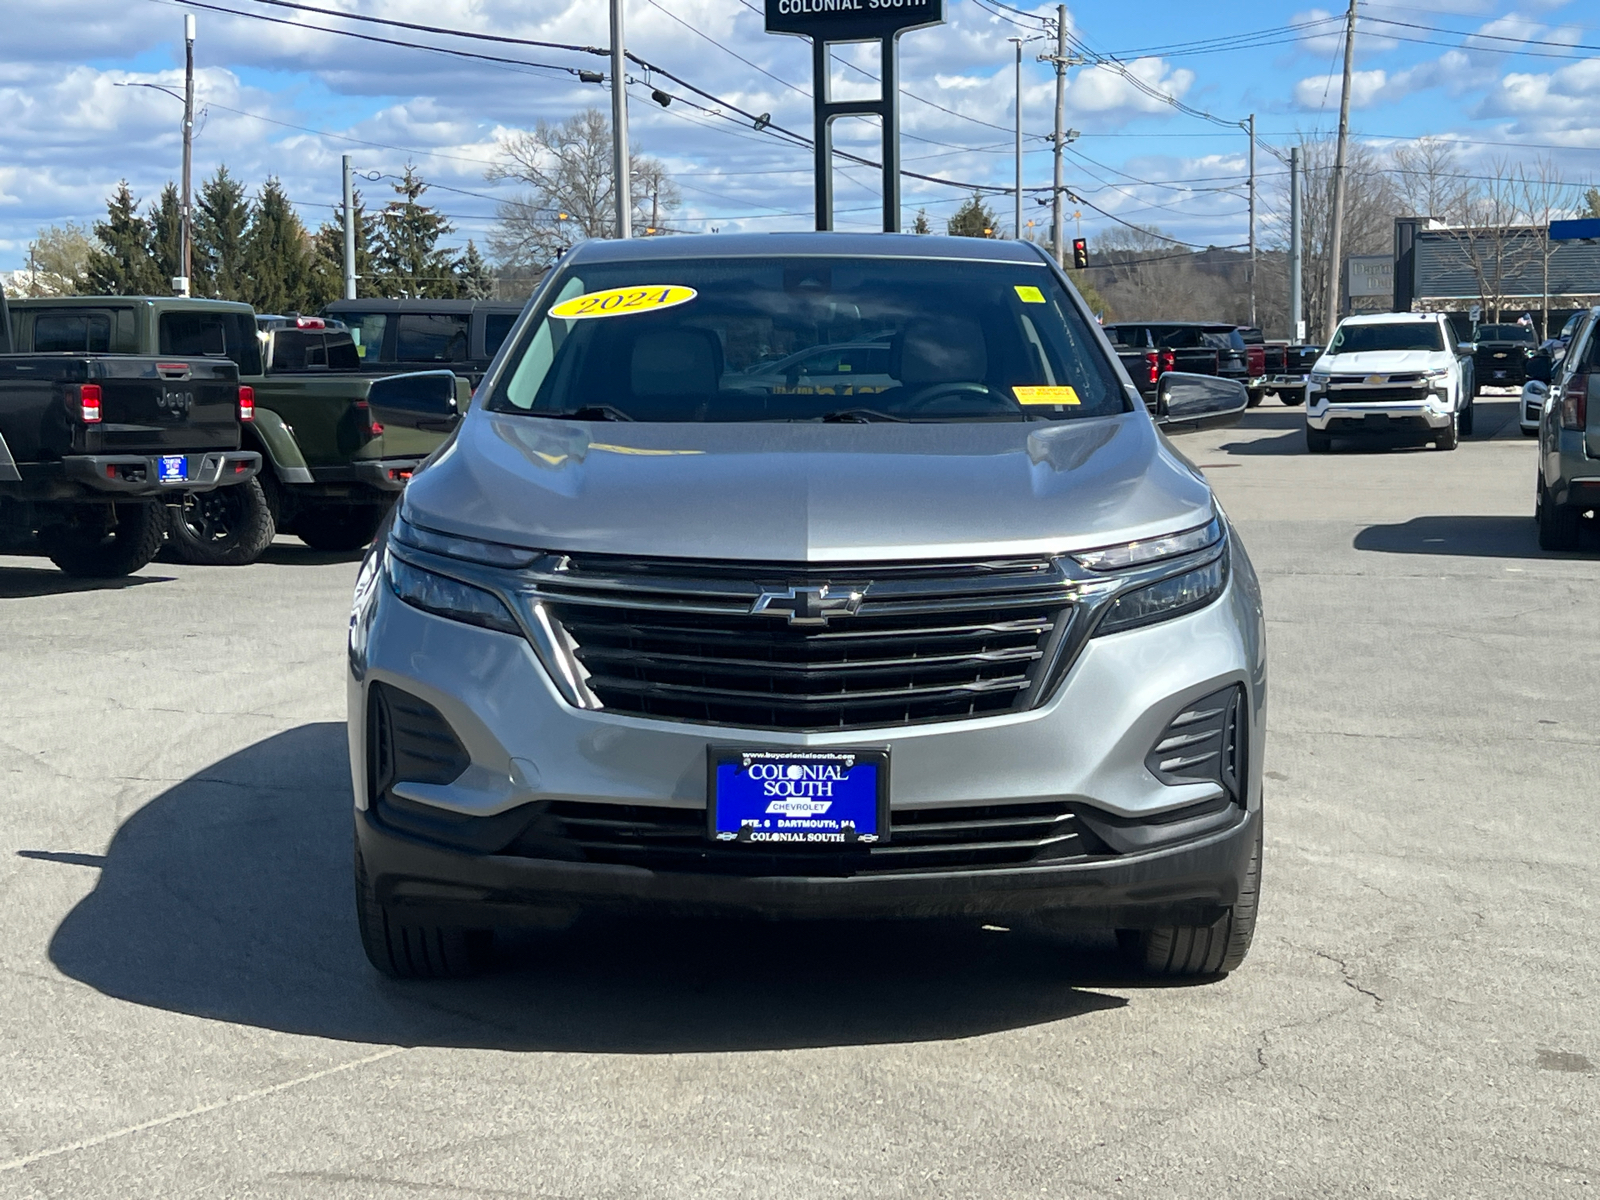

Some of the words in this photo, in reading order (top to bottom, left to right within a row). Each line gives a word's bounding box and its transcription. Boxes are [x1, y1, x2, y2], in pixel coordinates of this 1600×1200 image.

[779, 0, 863, 14] COLONIAL
[575, 289, 671, 315] 2024
[156, 386, 193, 411] Jeep
[748, 764, 848, 780] COLONIAL
[764, 781, 833, 796] SOUTH
[773, 803, 825, 811] CHEVROLET
[777, 820, 839, 829] DARTMOUTH,
[750, 832, 806, 842] COLONIAL
[807, 833, 846, 842] SOUTH
